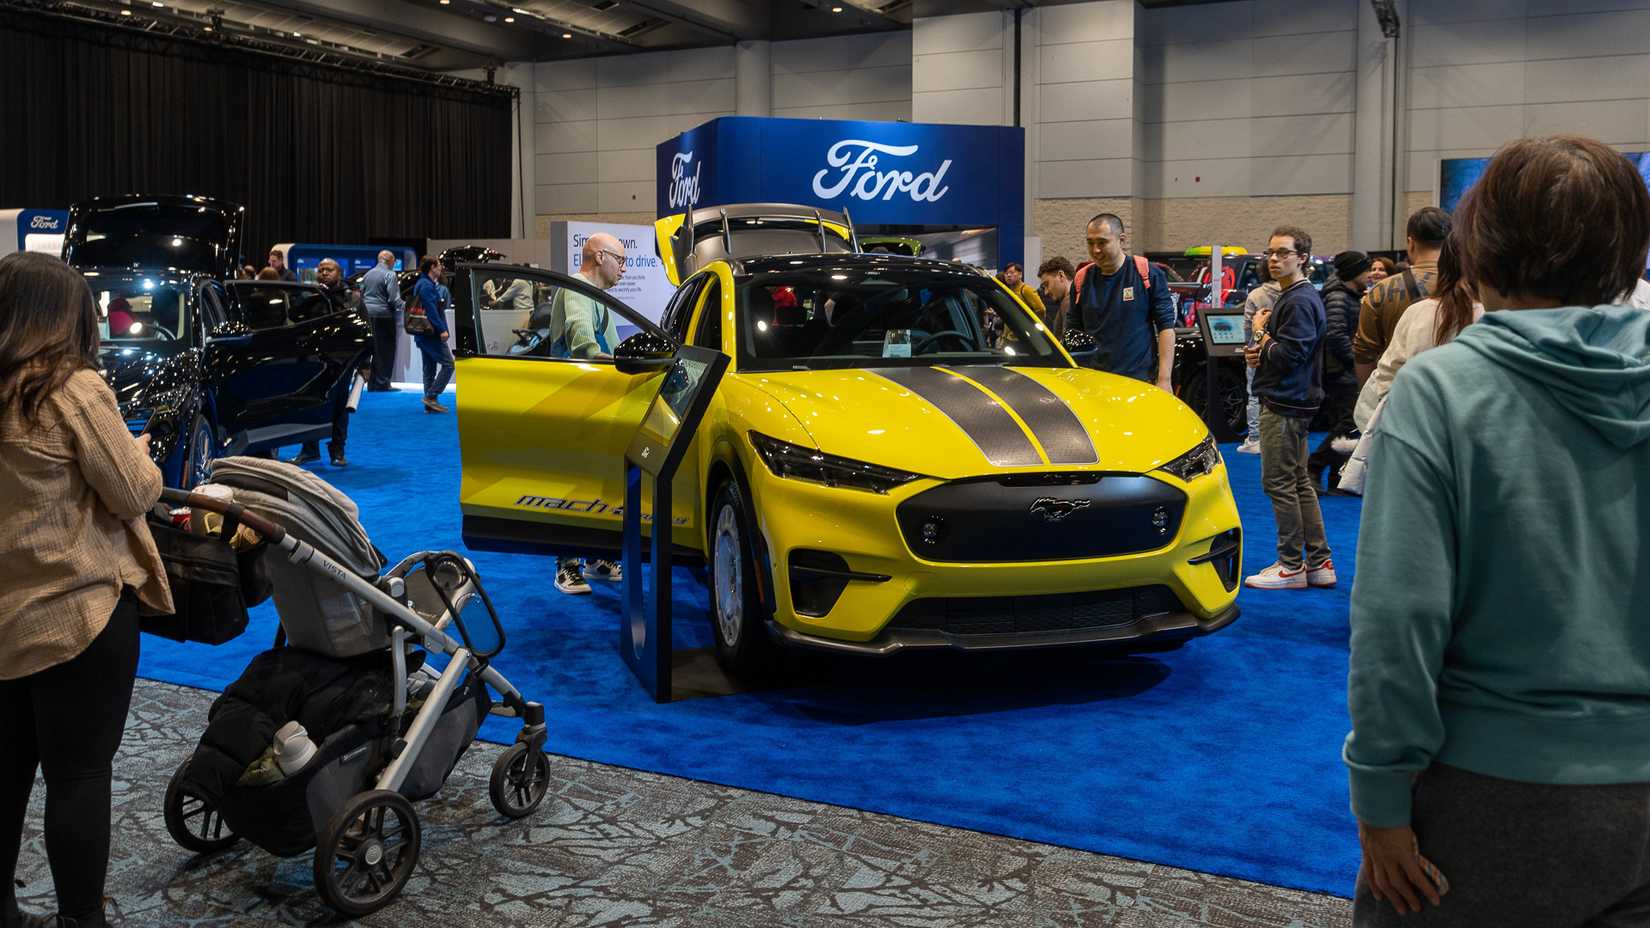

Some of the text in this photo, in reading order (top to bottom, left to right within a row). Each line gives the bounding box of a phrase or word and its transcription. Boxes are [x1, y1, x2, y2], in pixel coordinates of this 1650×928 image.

[669, 150, 701, 208] Ford
[812, 139, 952, 202] Ford
[31, 216, 59, 229] Ford
[322, 559, 347, 579] VISTA
